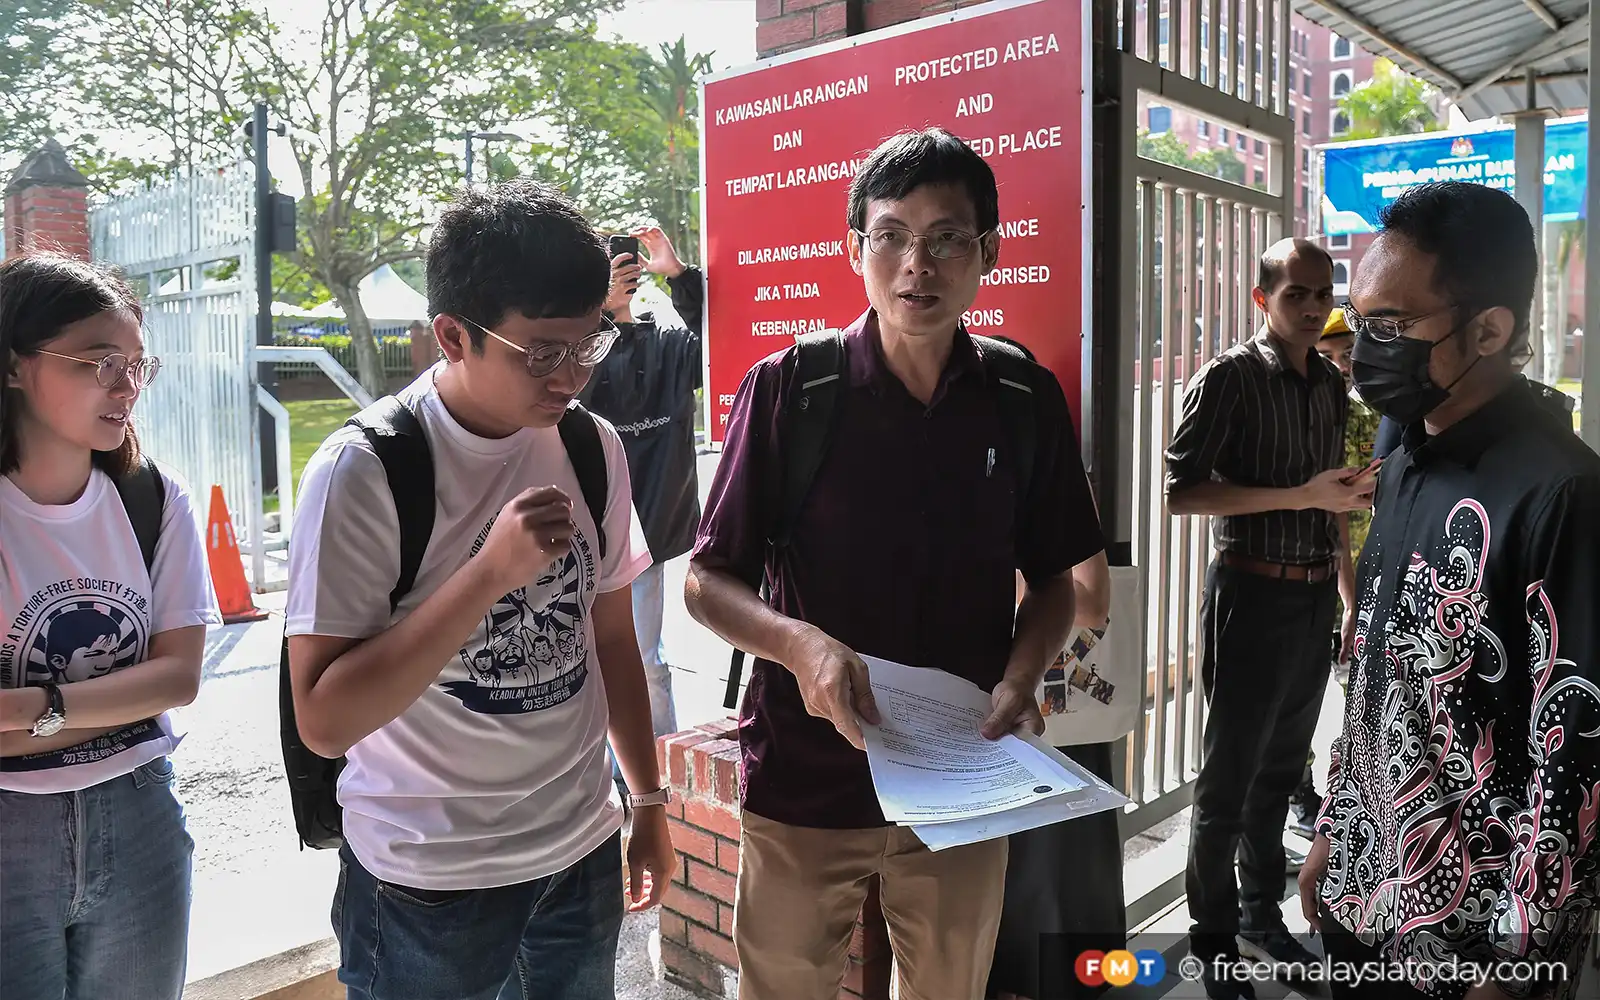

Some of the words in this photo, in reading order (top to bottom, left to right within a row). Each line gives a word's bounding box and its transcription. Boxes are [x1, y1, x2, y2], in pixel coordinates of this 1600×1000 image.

[894, 46, 998, 86] PROTECTED
[1002, 33, 1061, 64] AREA
[715, 95, 782, 126] KAWASAN
[784, 75, 868, 111] LARANGAN
[955, 92, 994, 118] AND
[772, 129, 803, 152] DAN
[998, 126, 1062, 155] PLACE
[725, 173, 774, 197] TEMPAT
[777, 159, 860, 189] LARANGAN
[738, 245, 798, 265] DILARANG
[799, 240, 844, 260] MASUK
[979, 265, 1051, 286] HORISED
[754, 286, 781, 302] JIKA
[783, 282, 821, 300] TIADA
[751, 318, 826, 336] KEBENARAN
[961, 308, 1005, 328] SONS
[77, 577, 123, 595] SOCIETY
[11, 578, 76, 632] TORTURE-FREE
[7, 633, 21, 643] A
[489, 688, 527, 701] KEADILAN
[528, 684, 550, 699] UNTUK
